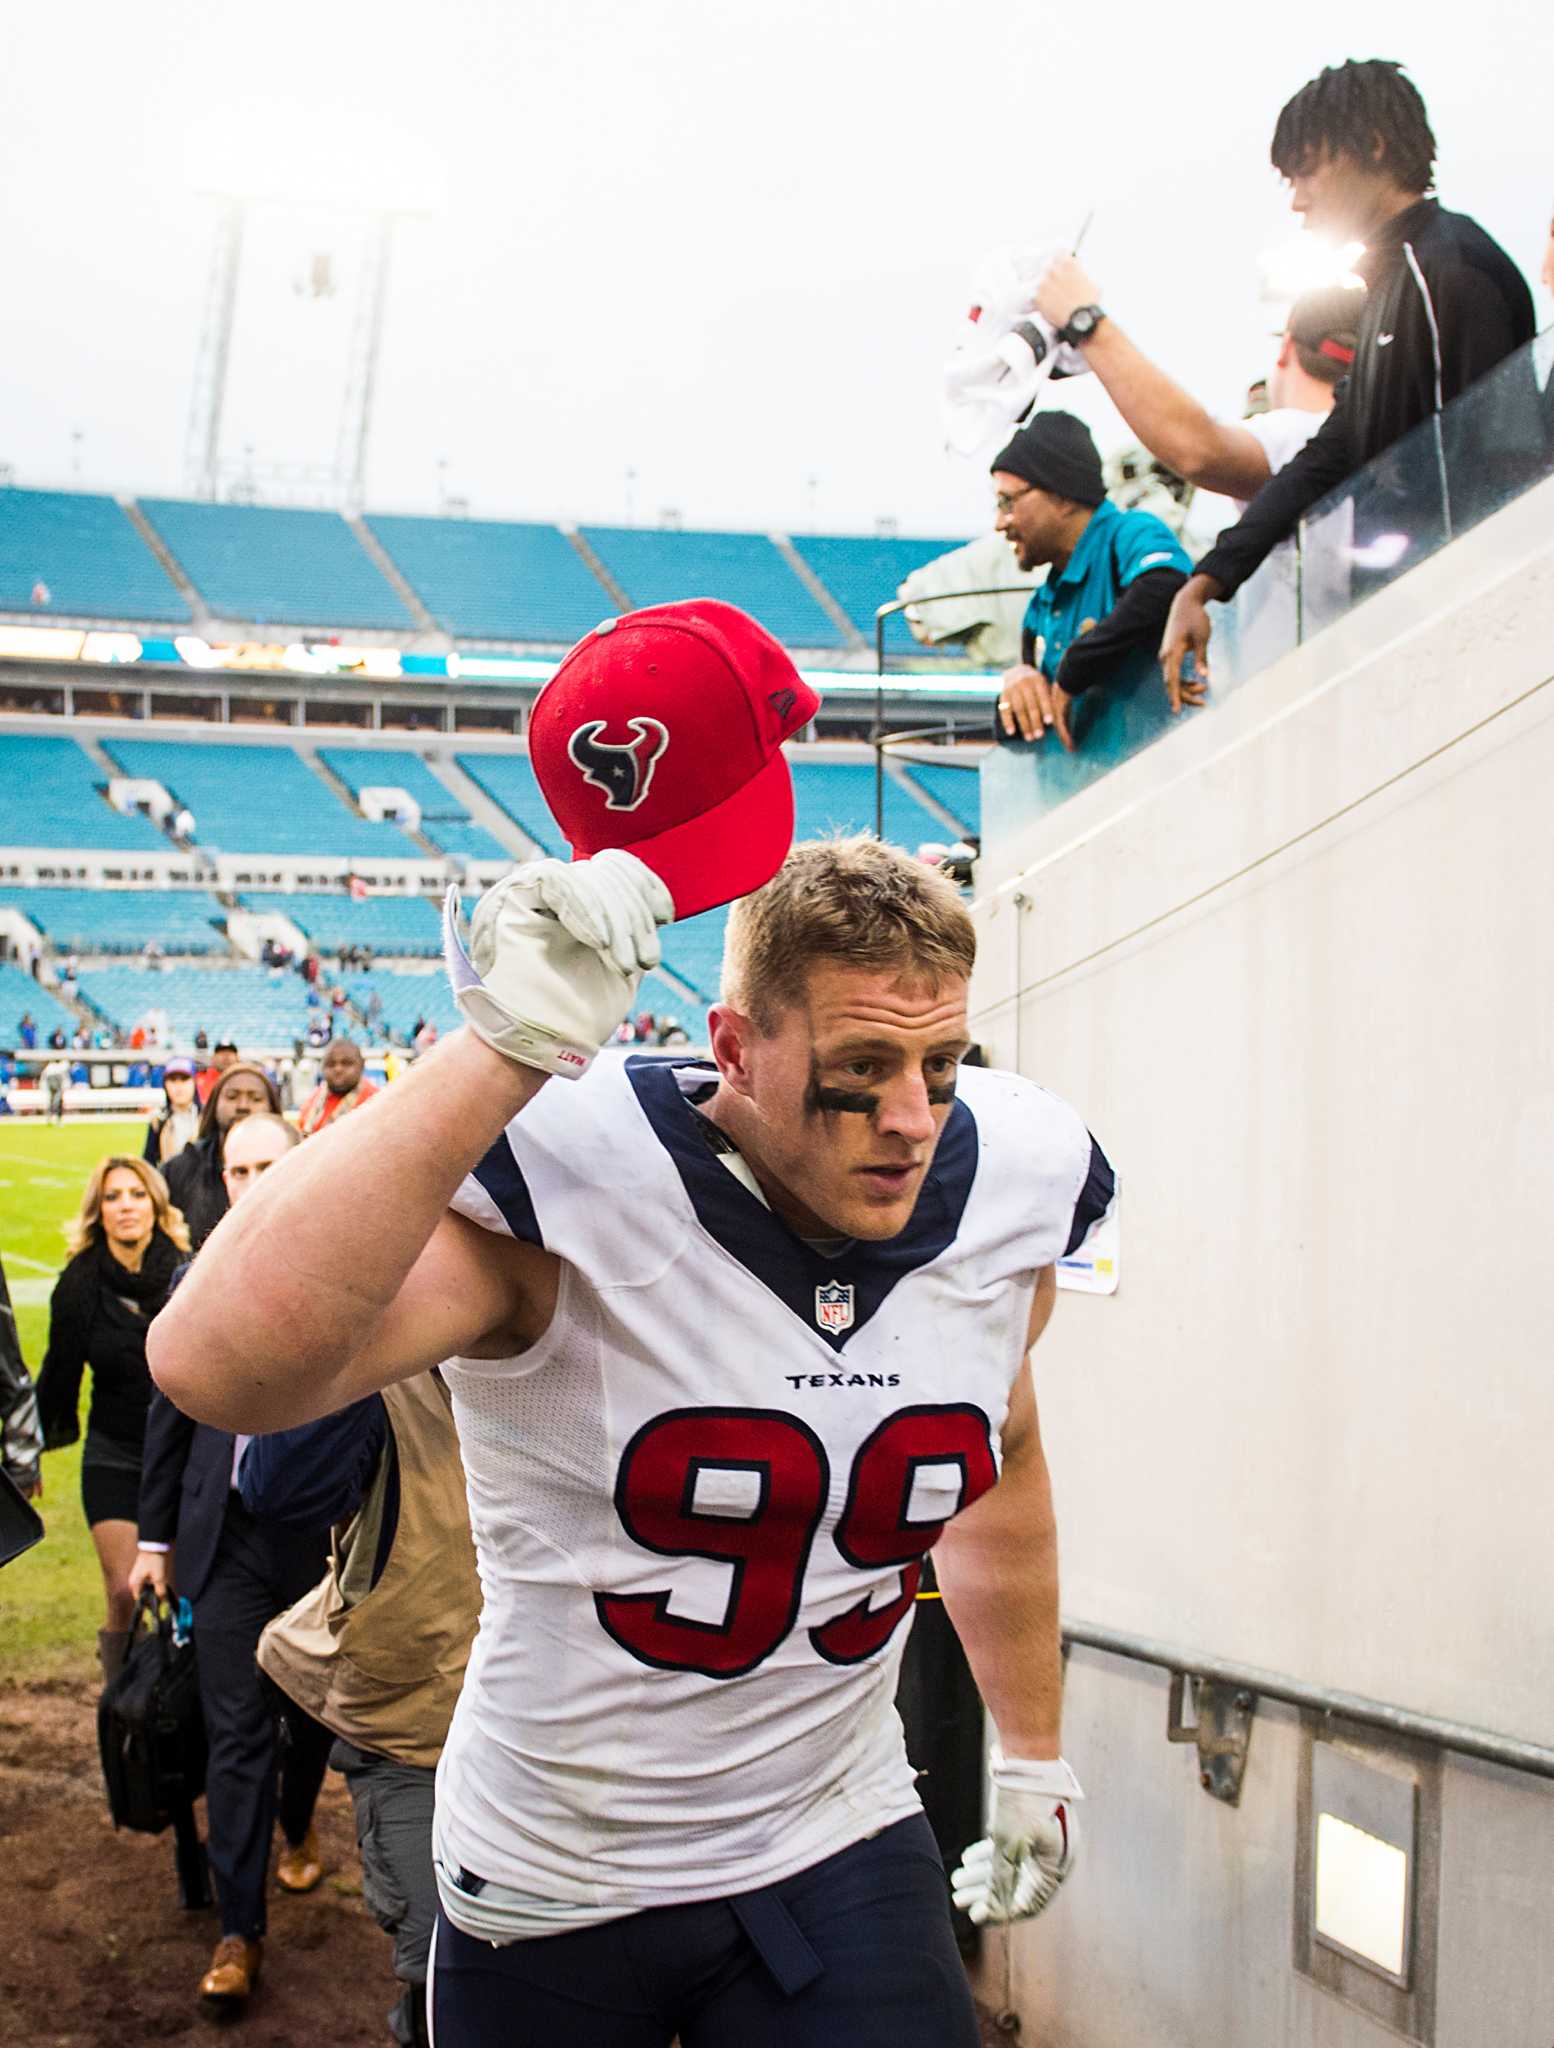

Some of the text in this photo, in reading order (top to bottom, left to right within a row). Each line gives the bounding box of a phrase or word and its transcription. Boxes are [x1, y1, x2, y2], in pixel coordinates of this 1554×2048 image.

[820, 1303, 849, 1324] NFL
[785, 1373, 901, 1389] TEXANS
[593, 1402, 998, 1679] 99
